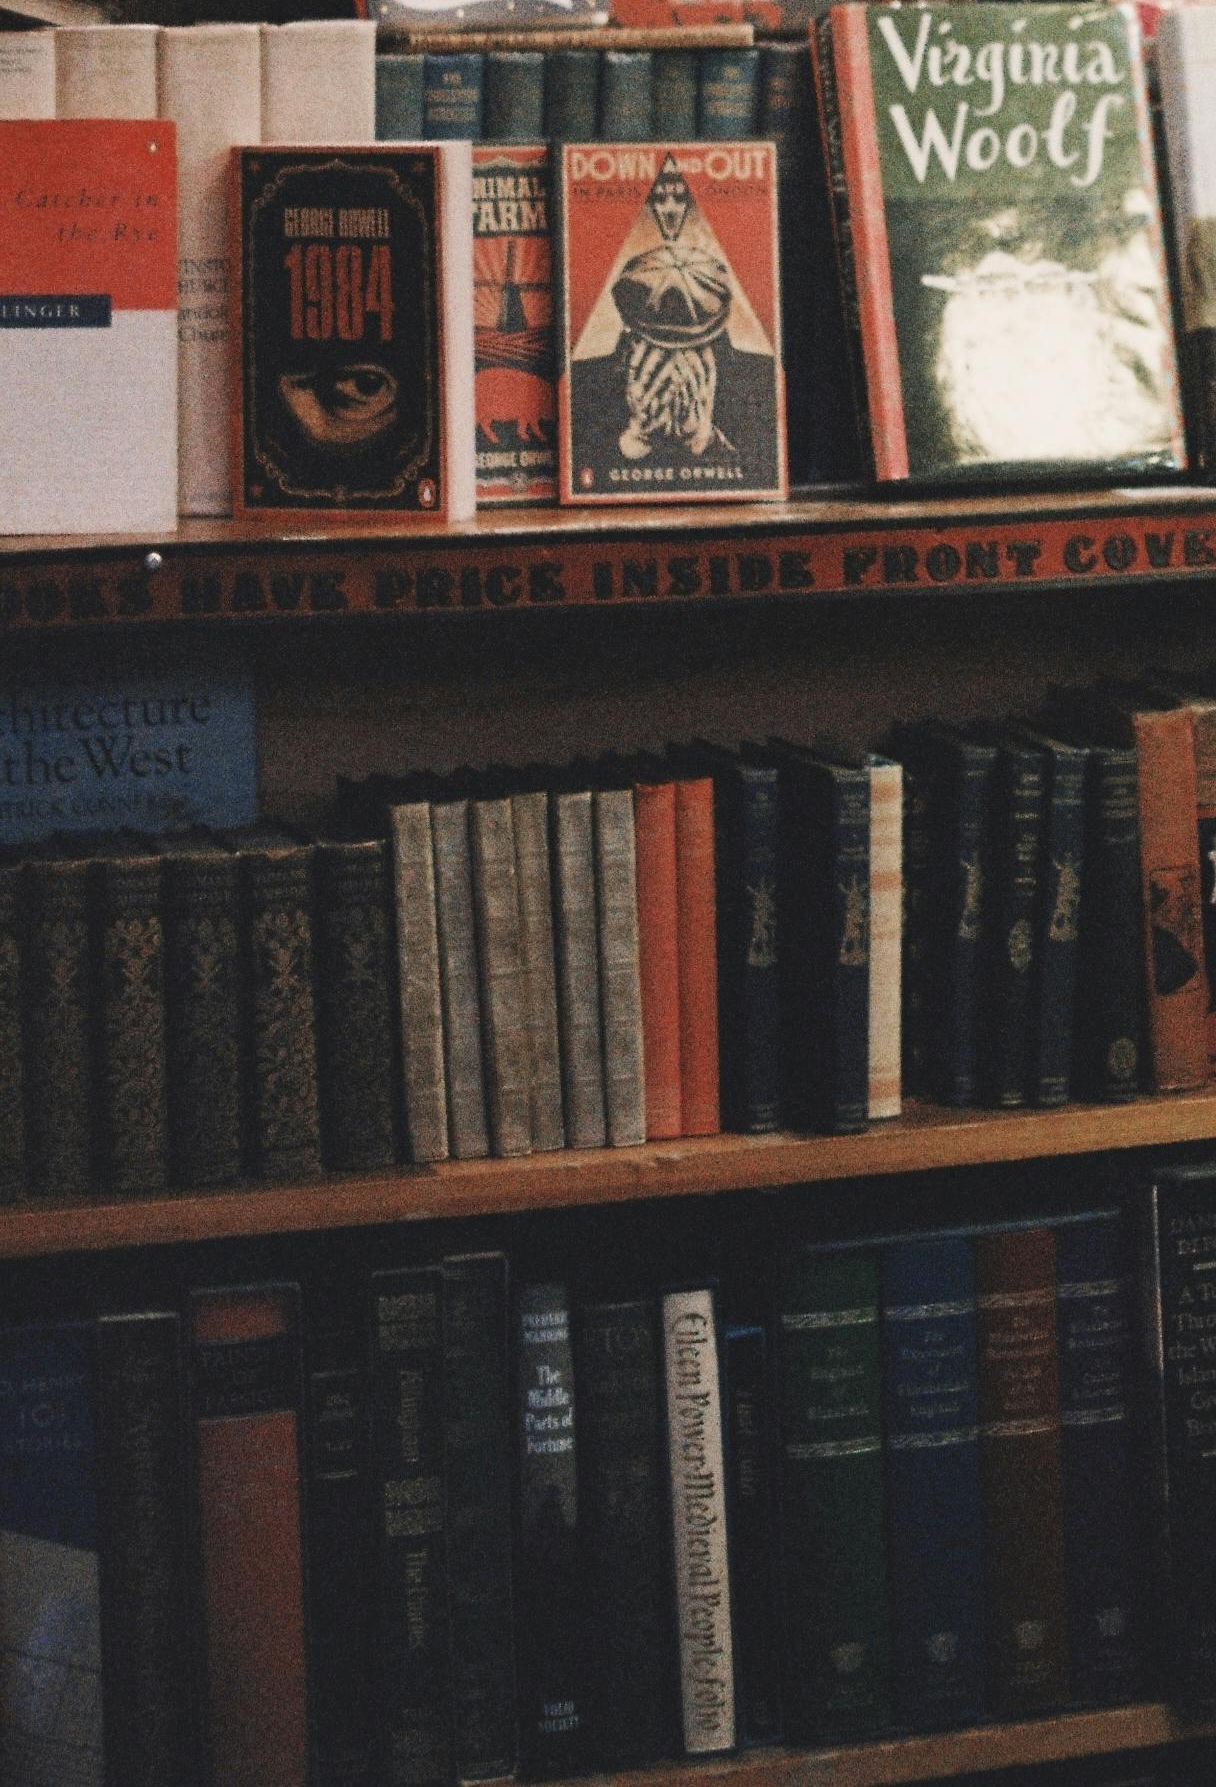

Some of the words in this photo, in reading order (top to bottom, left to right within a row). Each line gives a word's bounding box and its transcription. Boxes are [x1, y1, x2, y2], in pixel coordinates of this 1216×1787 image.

[878, 9, 1124, 115] Virginia
[571, 151, 656, 181] DOWN
[703, 151, 767, 181] OUT
[888, 90, 1127, 187] Woolf
[282, 242, 395, 343] 1984
[609, 466, 674, 483] GEORGE
[679, 465, 744, 482] ORWELL
[179, 564, 348, 615] HAVE
[376, 559, 567, 611] PRICE
[592, 549, 814, 601] INSIDE
[843, 539, 1042, 587] FRONT
[5, 740, 77, 785] the
[79, 733, 192, 778] West
[536, 1364, 561, 1385] The
[670, 1311, 709, 1389] Eileen
